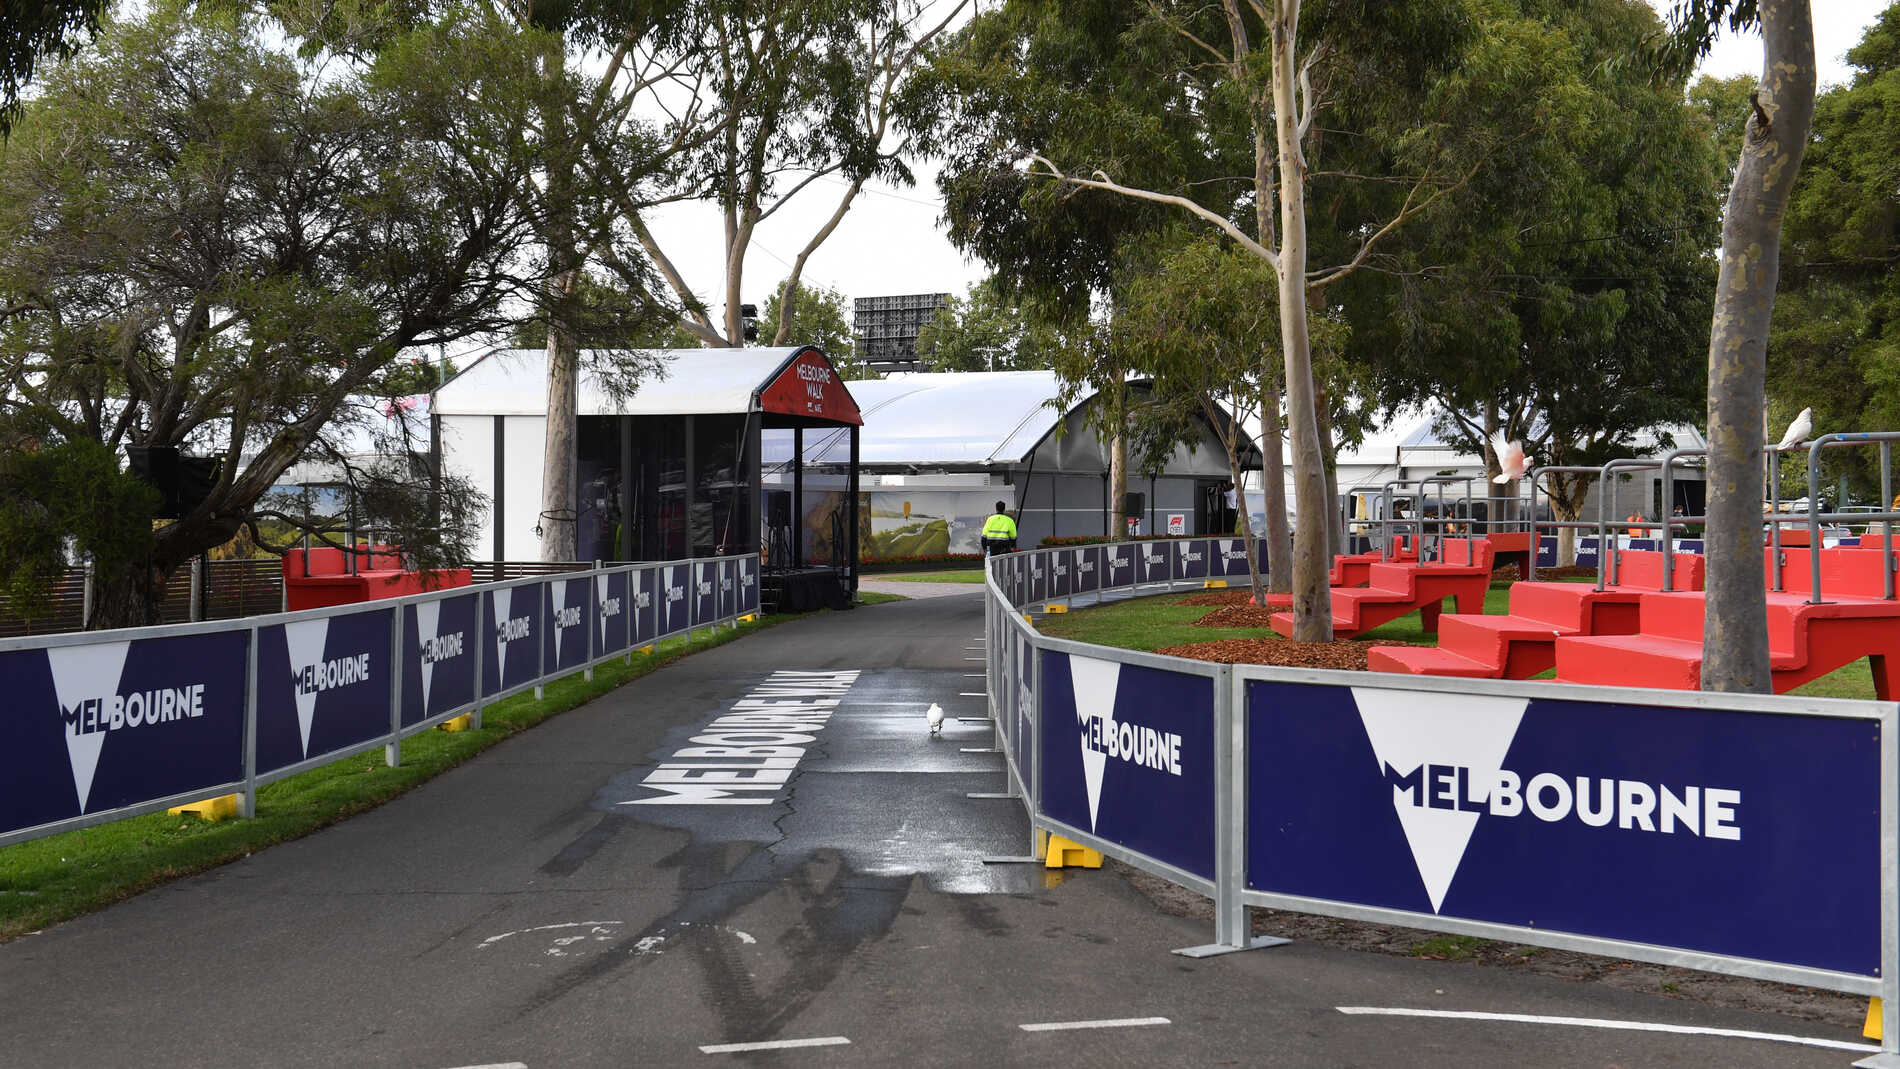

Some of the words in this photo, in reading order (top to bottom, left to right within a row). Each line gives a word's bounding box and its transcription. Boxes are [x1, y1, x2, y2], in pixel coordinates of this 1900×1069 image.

[797, 364, 830, 384] MELBOURNE
[806, 382, 824, 400] WALK
[420, 631, 464, 664] MELBOURNE
[496, 616, 530, 643] MELBOURNE
[292, 652, 370, 695] MELBOURNE
[61, 684, 205, 736] MELBOURNE
[616, 698, 842, 804] MELBOURNE
[745, 669, 862, 698] WALK
[1078, 712, 1182, 776] MELBOURNE
[1384, 759, 1742, 841] MELBOURNE
